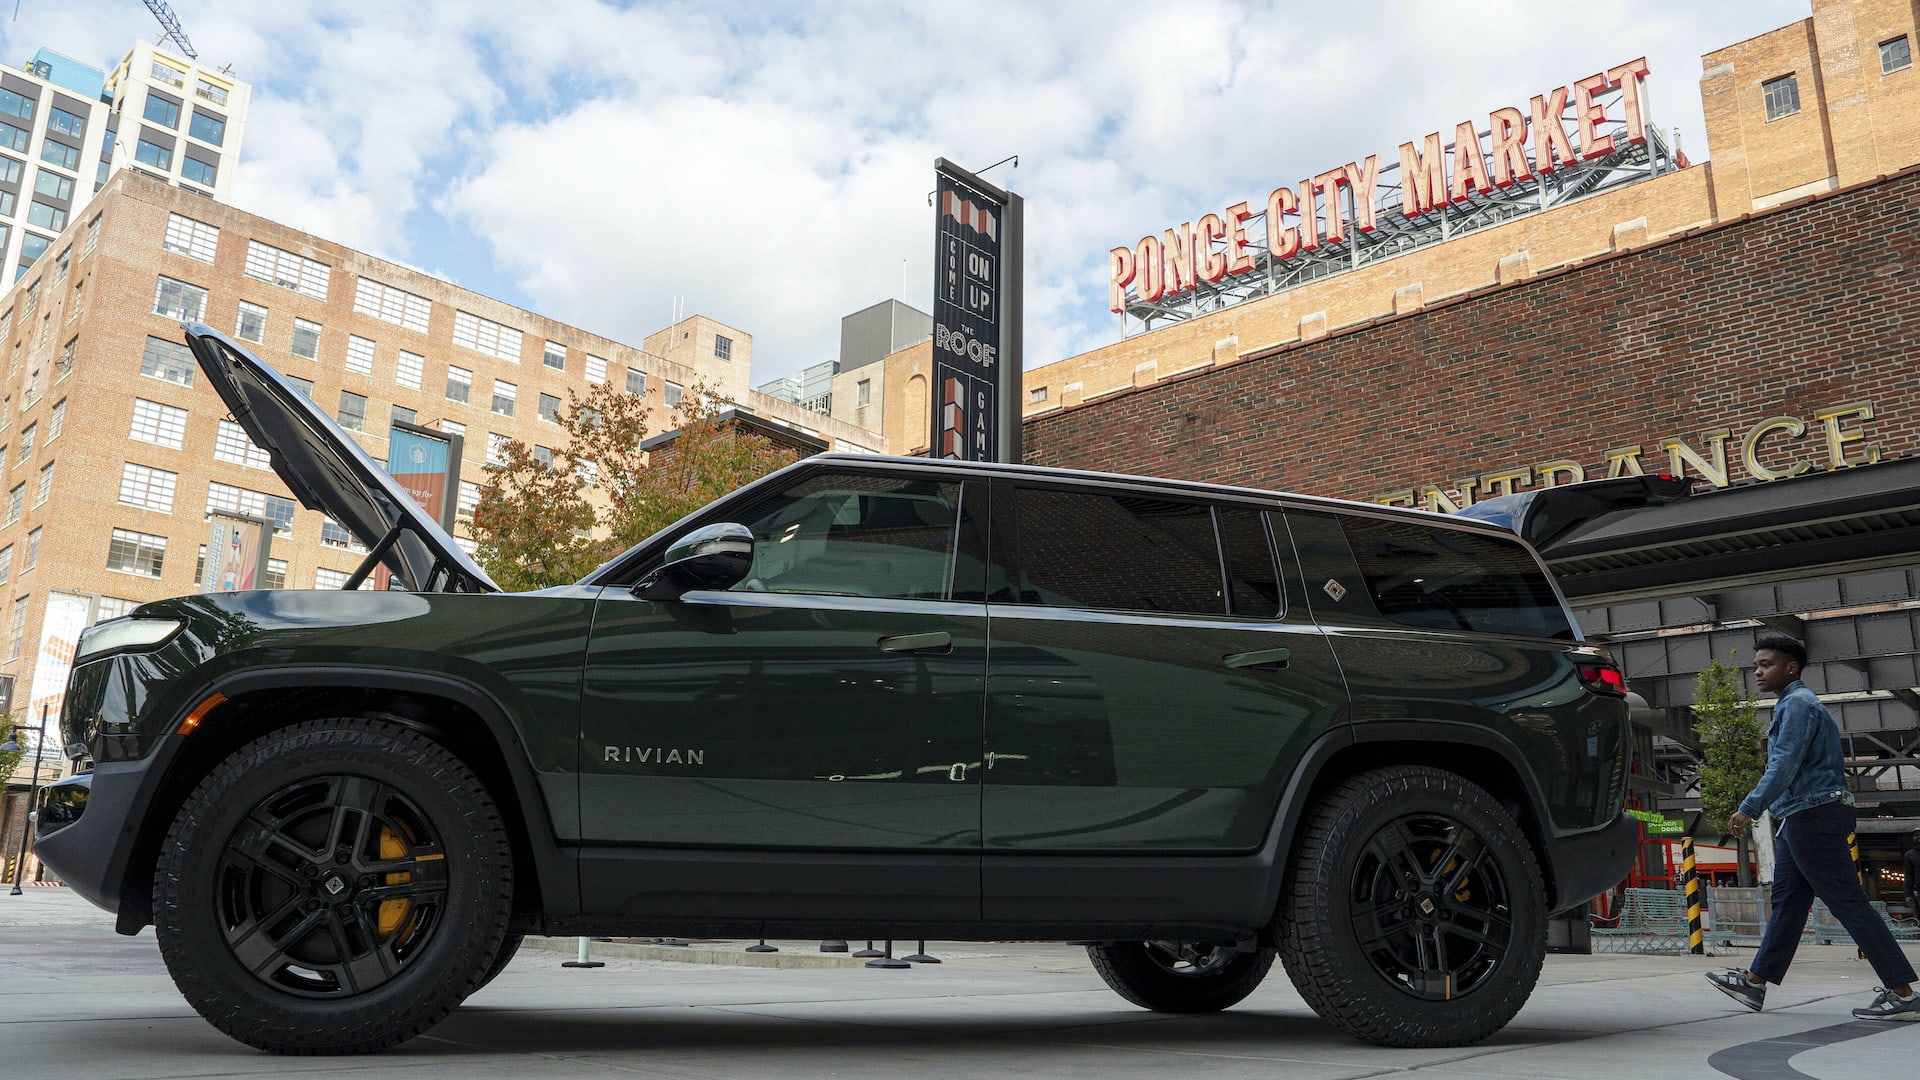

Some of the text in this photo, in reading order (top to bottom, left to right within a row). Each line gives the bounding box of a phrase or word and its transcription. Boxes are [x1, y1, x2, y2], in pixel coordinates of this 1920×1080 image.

[1110, 55, 1651, 313] PONCE CITY MARKET
[949, 240, 957, 300] COME
[968, 252, 990, 282] ON
[968, 286, 990, 313] UP
[936, 322, 997, 367] ROOF
[960, 323, 975, 336] THE
[604, 745, 704, 765] RIVIAN
